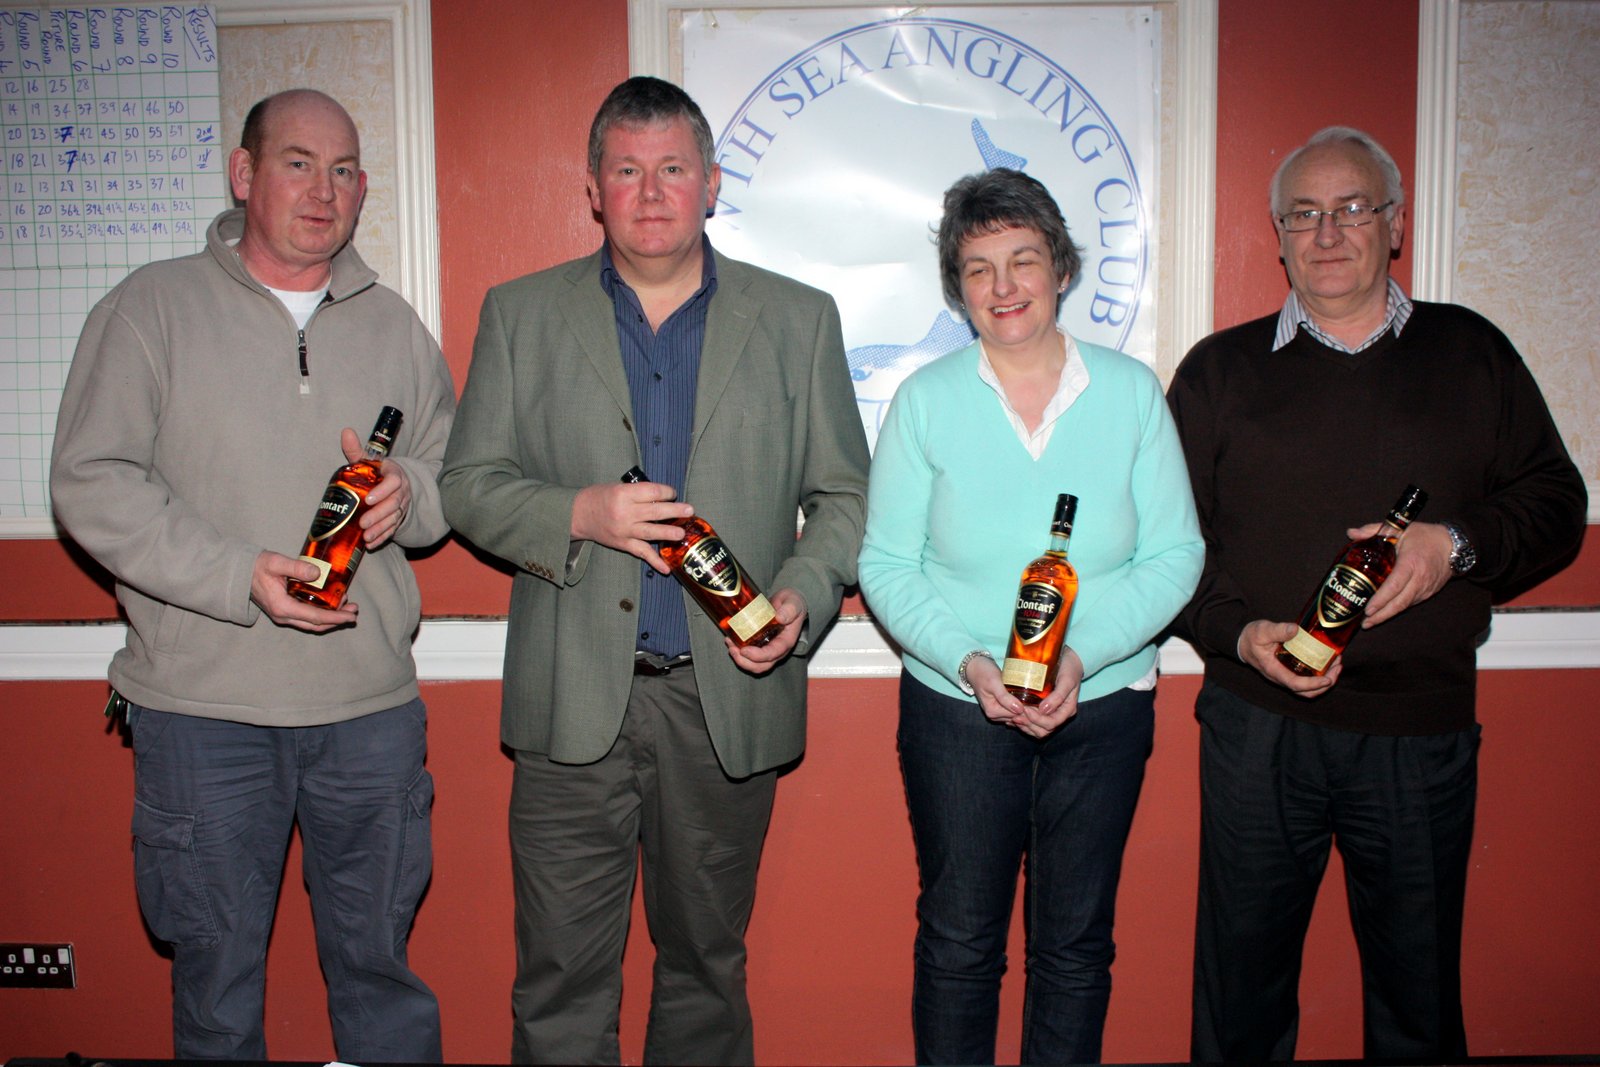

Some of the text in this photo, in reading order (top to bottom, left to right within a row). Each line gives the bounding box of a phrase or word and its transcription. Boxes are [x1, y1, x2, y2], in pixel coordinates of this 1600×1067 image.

[186, 8, 215, 63] RESULTS
[117, 55, 134, 66] 8
[140, 53, 158, 64] 9
[162, 53, 179, 68] 10
[23, 60, 40, 72] 5
[72, 60, 88, 72] 6
[92, 59, 111, 72] 7
[769, 40, 873, 120] SEA
[882, 26, 1115, 165] ANGLING
[1089, 177, 1140, 328] CLUB
[1328, 577, 1368, 607] Clontarf
